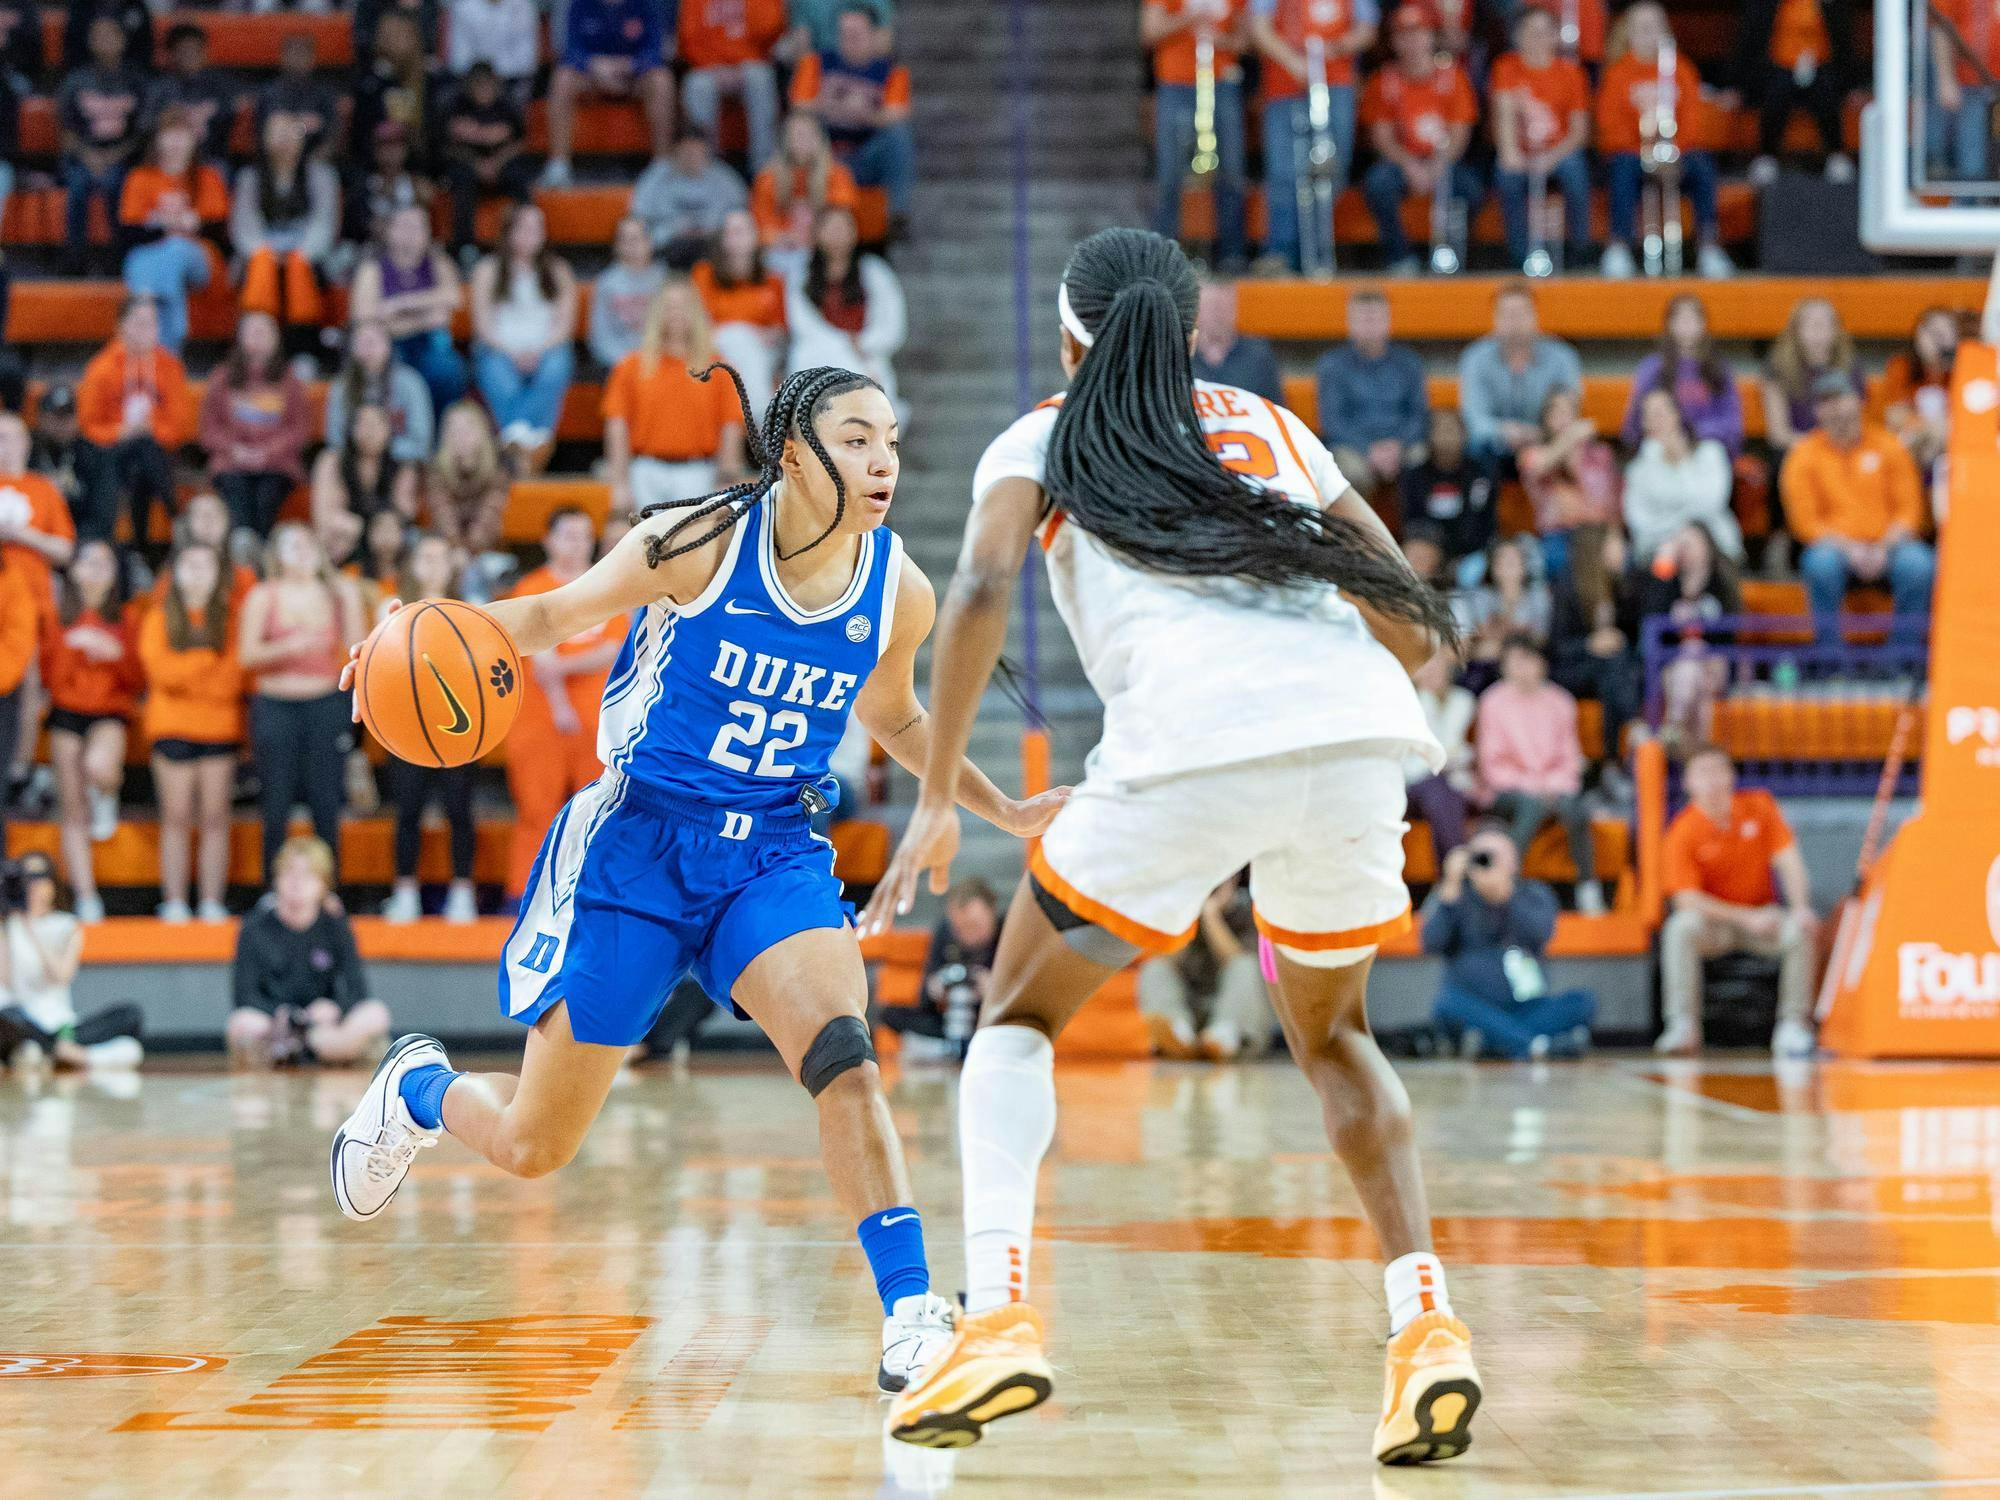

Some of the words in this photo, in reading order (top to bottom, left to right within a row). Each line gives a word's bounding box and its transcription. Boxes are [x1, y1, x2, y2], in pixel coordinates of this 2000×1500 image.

[850, 623, 869, 631] ACC
[710, 639, 857, 710] DUKE
[707, 700, 808, 778] 22
[718, 811, 753, 841] D
[518, 932, 560, 974] D
[107, 1314, 662, 1431] FOUNDERS
